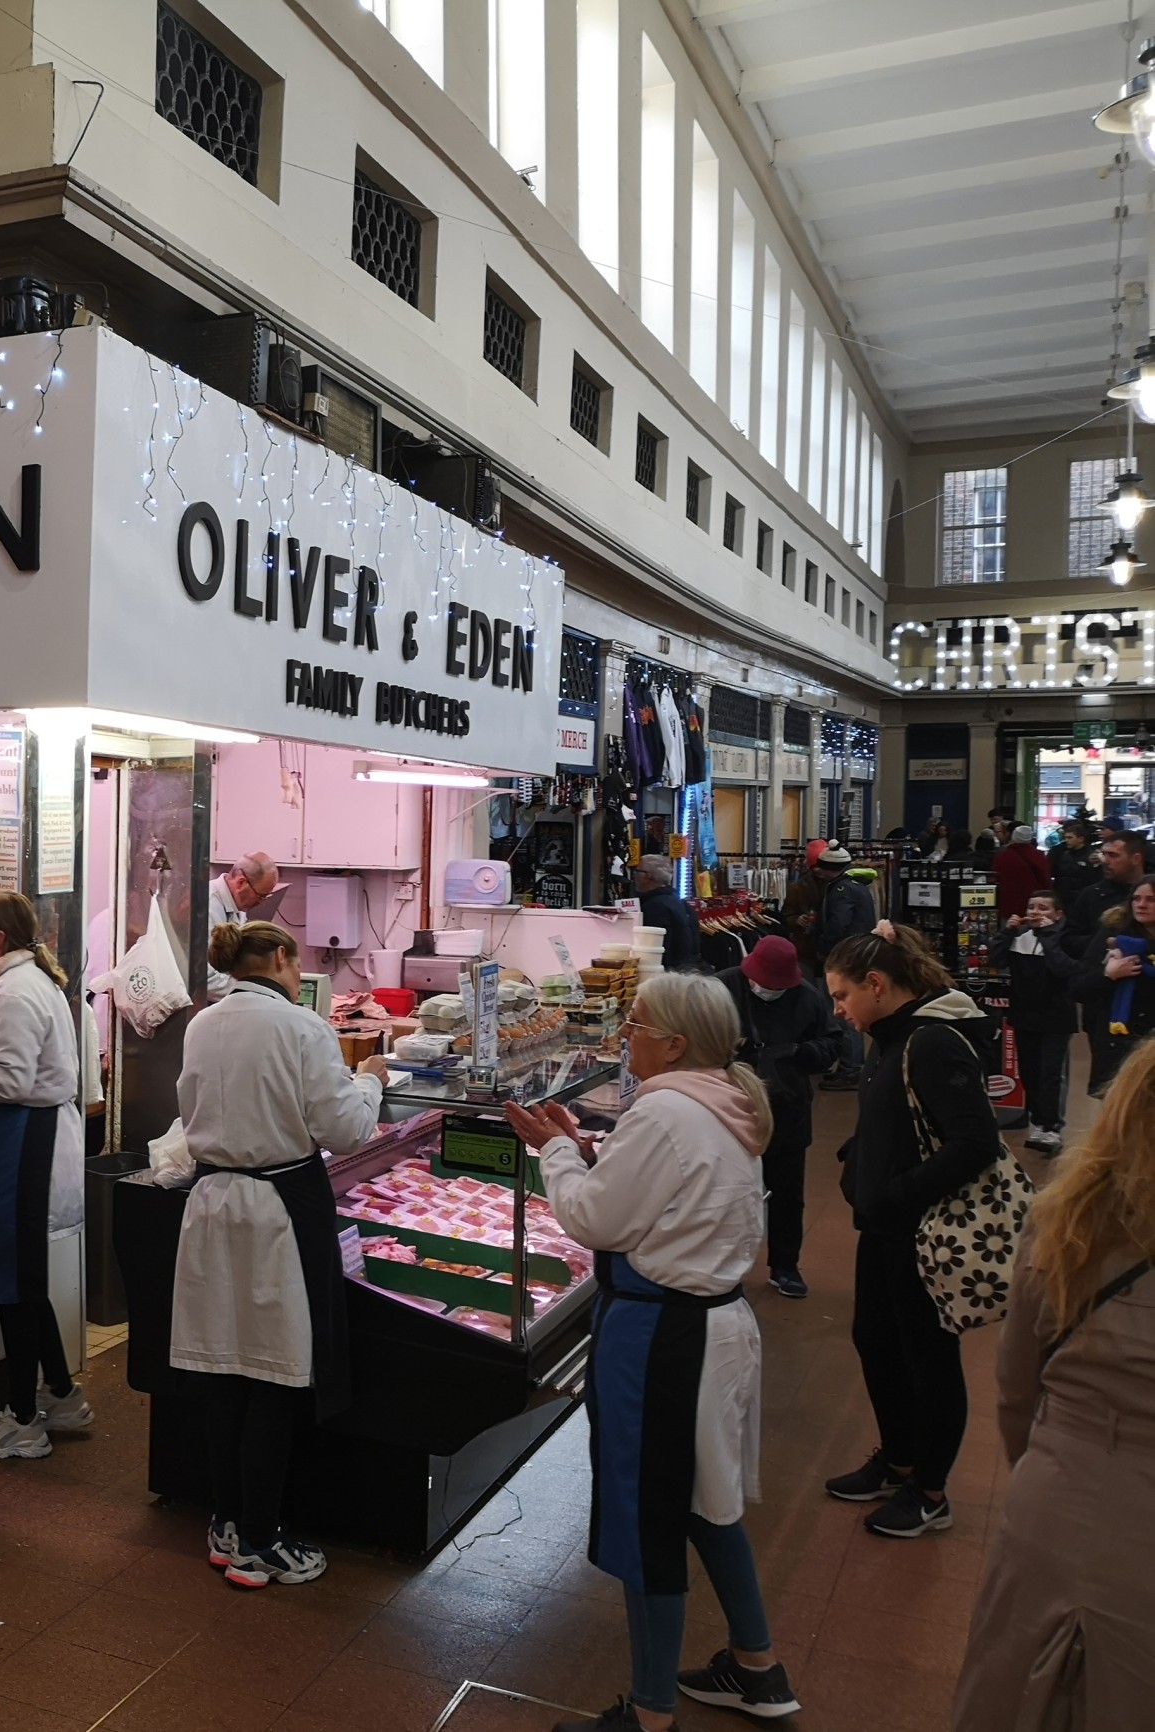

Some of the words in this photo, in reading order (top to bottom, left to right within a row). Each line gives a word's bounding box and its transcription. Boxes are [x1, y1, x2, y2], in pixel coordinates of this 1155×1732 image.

[178, 501, 379, 651] OLIVER
[402, 610, 419, 661] &
[446, 601, 534, 692] EDEN
[286, 658, 364, 718] FAMILY
[376, 681, 470, 736] BUTCHERS
[561, 729, 588, 750] MERCH
[542, 881, 566, 891] born
[621, 900, 635, 908] SALE
[132, 977, 147, 993] ECO
[502, 1154, 510, 1165] 5
